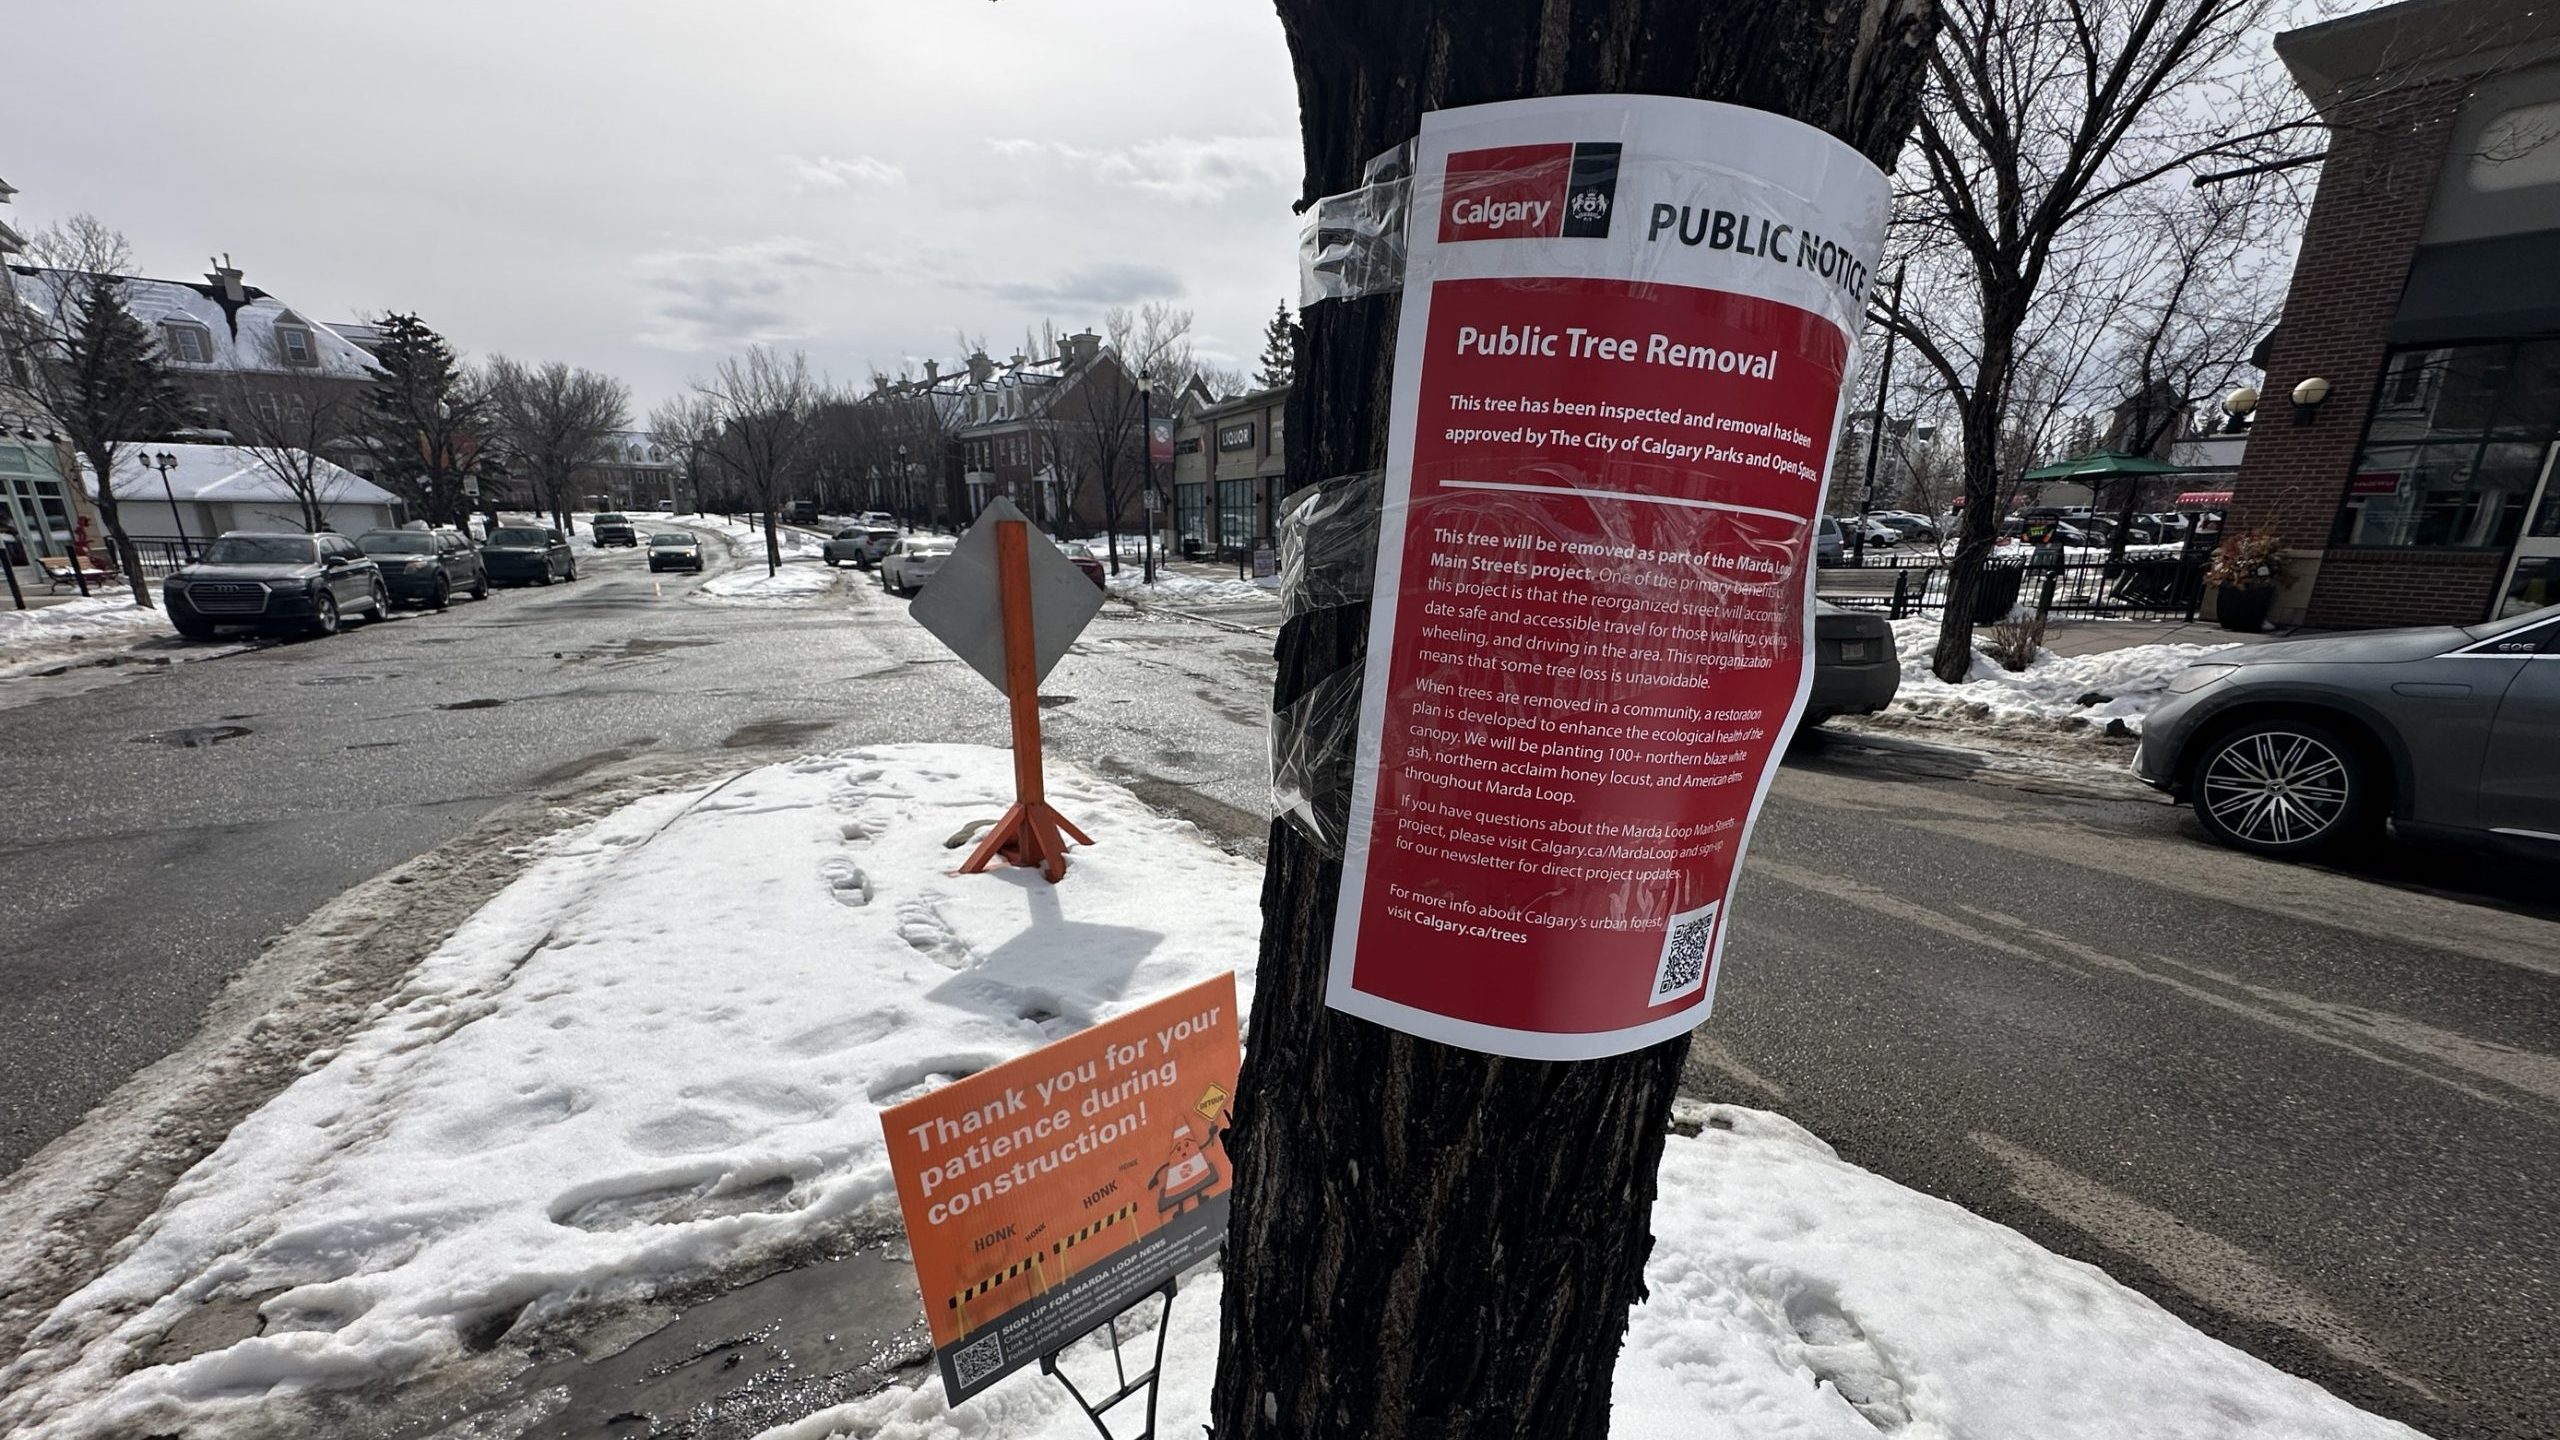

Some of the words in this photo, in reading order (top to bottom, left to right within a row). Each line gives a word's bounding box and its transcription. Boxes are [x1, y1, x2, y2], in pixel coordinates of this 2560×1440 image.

[1451, 197, 1551, 229] Calgary
[1648, 203, 1793, 263] PUBLIC
[1797, 230, 1867, 302] NOTICE
[1457, 325, 1558, 356] Public
[1566, 327, 1638, 361] Tree
[1646, 334, 1777, 380] Removal
[1222, 429, 1248, 446] LIQUOR
[1450, 395, 1481, 411] This
[1484, 397, 1517, 412] tree
[1520, 396, 1550, 414] has
[1553, 397, 1596, 416] been
[1599, 401, 1681, 424] inspected
[1683, 412, 1714, 428] and
[1716, 418, 1772, 437] removal
[1773, 423, 1793, 442] has
[1793, 428, 1812, 448] been
[1445, 427, 1522, 444] approved
[1525, 428, 1547, 448] by
[1549, 429, 1581, 447] The
[1584, 431, 1618, 452] City
[1621, 435, 1641, 451] of
[1641, 437, 1702, 462] Calgary
[1704, 444, 1744, 464] Parks
[1745, 453, 1771, 468] and
[1772, 455, 1797, 474] Open
[1434, 528, 1464, 544] This
[1467, 532, 1499, 547] tree
[1503, 534, 1533, 550] will
[1535, 536, 1557, 552] be
[1560, 541, 1634, 560] removed
[1637, 548, 1655, 561] as
[1658, 550, 1691, 567] part
[1694, 552, 1710, 566] of
[1711, 554, 1735, 569] the
[1736, 555, 1774, 574] Marda
[1431, 552, 1467, 569] Main
[1471, 555, 1528, 575] Streets
[1531, 564, 1596, 581] project.
[1679, 578, 1731, 597] primary
[1428, 577, 1452, 592] this
[1455, 580, 1508, 599] project
[1511, 585, 1523, 599] is
[1527, 586, 1558, 603] that
[1562, 590, 1588, 606] the
[1591, 595, 1680, 614] reorganized
[1682, 602, 1719, 617] street
[1722, 606, 1743, 620] will
[1424, 601, 1456, 617] date
[1458, 605, 1487, 620] safe
[1490, 609, 1520, 624] and
[1523, 614, 1601, 632] accessible
[1604, 620, 1645, 636] travel
[1649, 621, 1668, 637] for
[1671, 625, 1708, 641] those
[1493, 635, 1523, 649] and
[1526, 638, 1580, 658] driving
[1584, 641, 1598, 655] in
[1601, 643, 1626, 659] the
[1629, 649, 1663, 662] area.
[1667, 649, 1693, 664] This
[1695, 653, 1773, 669] reorganization
[2498, 643, 2535, 651] EQE
[1419, 649, 1464, 666] means
[1467, 653, 1497, 670] that
[1500, 660, 1543, 674] some
[1546, 663, 1576, 679] tree
[1579, 665, 1607, 681] loss
[1611, 669, 1622, 683] is
[1625, 671, 1711, 689] unavoidable.
[1415, 677, 1454, 695] When
[1458, 684, 1493, 701] trees
[1496, 692, 1520, 704] are
[1523, 695, 1591, 712] removed
[1594, 699, 1608, 713] in
[1623, 703, 1701, 723] community,
[1713, 708, 1762, 722] restoration
[1409, 724, 1461, 745] canopy.
[1464, 731, 1487, 747] We
[1490, 736, 1515, 751] will
[1519, 738, 1539, 754] be
[1541, 741, 1604, 762] planting
[1608, 747, 1643, 762] 100+
[1645, 750, 1701, 765] northern
[1704, 752, 1728, 766] blaze
[1412, 701, 1441, 717] plan
[1444, 706, 1455, 719] is
[1458, 708, 1537, 730] developed
[1540, 719, 1556, 732] to
[1559, 720, 1623, 738] enhance
[1626, 725, 1649, 740] the
[1651, 729, 1714, 746] ecological
[1716, 729, 1743, 743] health
[1405, 766, 1482, 793] throughout
[1485, 779, 1532, 798] Marda
[1535, 786, 1576, 805] Loop.
[1407, 745, 1433, 762] ash,
[1435, 751, 1498, 771] northern
[1501, 761, 1557, 779] acclaim
[1560, 766, 1607, 785] honey
[1610, 770, 1653, 787] locust,
[1656, 773, 1681, 787] and
[1683, 773, 1728, 787] American
[1398, 818, 1446, 838] project,
[1449, 827, 1495, 846] please
[1499, 836, 1528, 850] visit
[1679, 844, 1698, 858] and
[1401, 794, 1411, 807] If
[1411, 799, 1436, 813] you
[1439, 802, 1472, 820] have
[1475, 811, 1546, 830] questions
[1549, 819, 1592, 835] about
[1596, 822, 1618, 837] the
[1621, 824, 1662, 838] Marda
[1665, 826, 1692, 840] Loop
[1693, 823, 1714, 836] Main
[1396, 835, 1413, 850] for
[1415, 843, 1438, 855] our
[1441, 848, 1515, 870] newsletter
[1518, 858, 1539, 873] for
[1541, 862, 1583, 878] direct
[1585, 866, 1633, 882] project
[1387, 905, 1412, 921] visit
[1414, 911, 1527, 944] Calgary.ca/trees
[1390, 884, 1409, 899] For
[1412, 892, 1447, 908] more
[1450, 898, 1476, 915] info
[1479, 905, 1522, 922] about
[1590, 916, 1627, 929] urban
[907, 1088, 1029, 1153] Thank
[1035, 1058, 1097, 1104] you
[1104, 1039, 1149, 1072] for
[1156, 1003, 1221, 1055] your
[918, 1107, 1071, 1196] patience
[1080, 1058, 1178, 1118] during
[927, 1099, 1149, 1226] construction!
[1118, 1158, 1138, 1172] HONK
[1082, 1179, 1119, 1209] HONK
[974, 1223, 1017, 1253] HONK
[1024, 1222, 1047, 1243] HONK
[1002, 1315, 1030, 1336] SIGN
[1032, 1305, 1047, 1319] UP
[1049, 1292, 1070, 1309] FOR
[1072, 1271, 1110, 1296] MARDA
[1111, 1254, 1138, 1274] LOOP
[1139, 1238, 1166, 1258] NEWS
